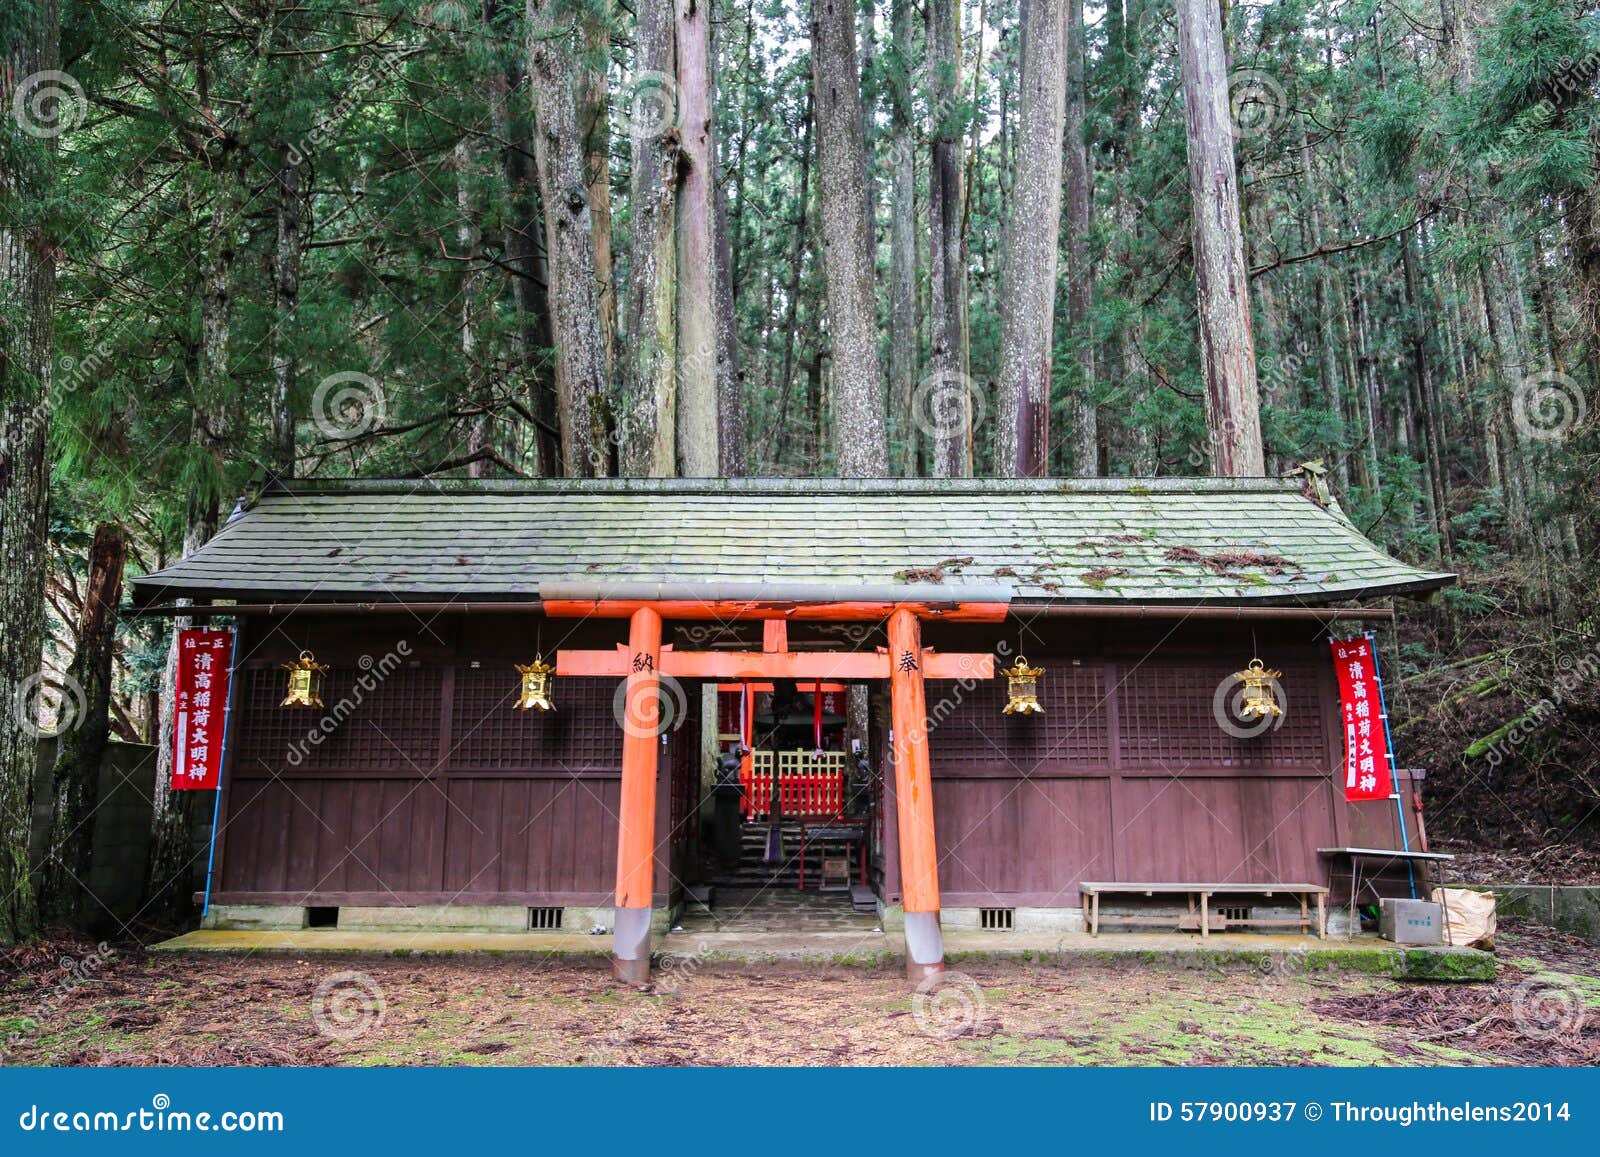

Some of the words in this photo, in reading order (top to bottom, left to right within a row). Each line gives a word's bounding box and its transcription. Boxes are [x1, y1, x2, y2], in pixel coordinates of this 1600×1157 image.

[188, 652, 214, 782] 清高稲荷大明神
[898, 650, 919, 679] 奉
[1349, 661, 1377, 793] 清高稲荷大明神
